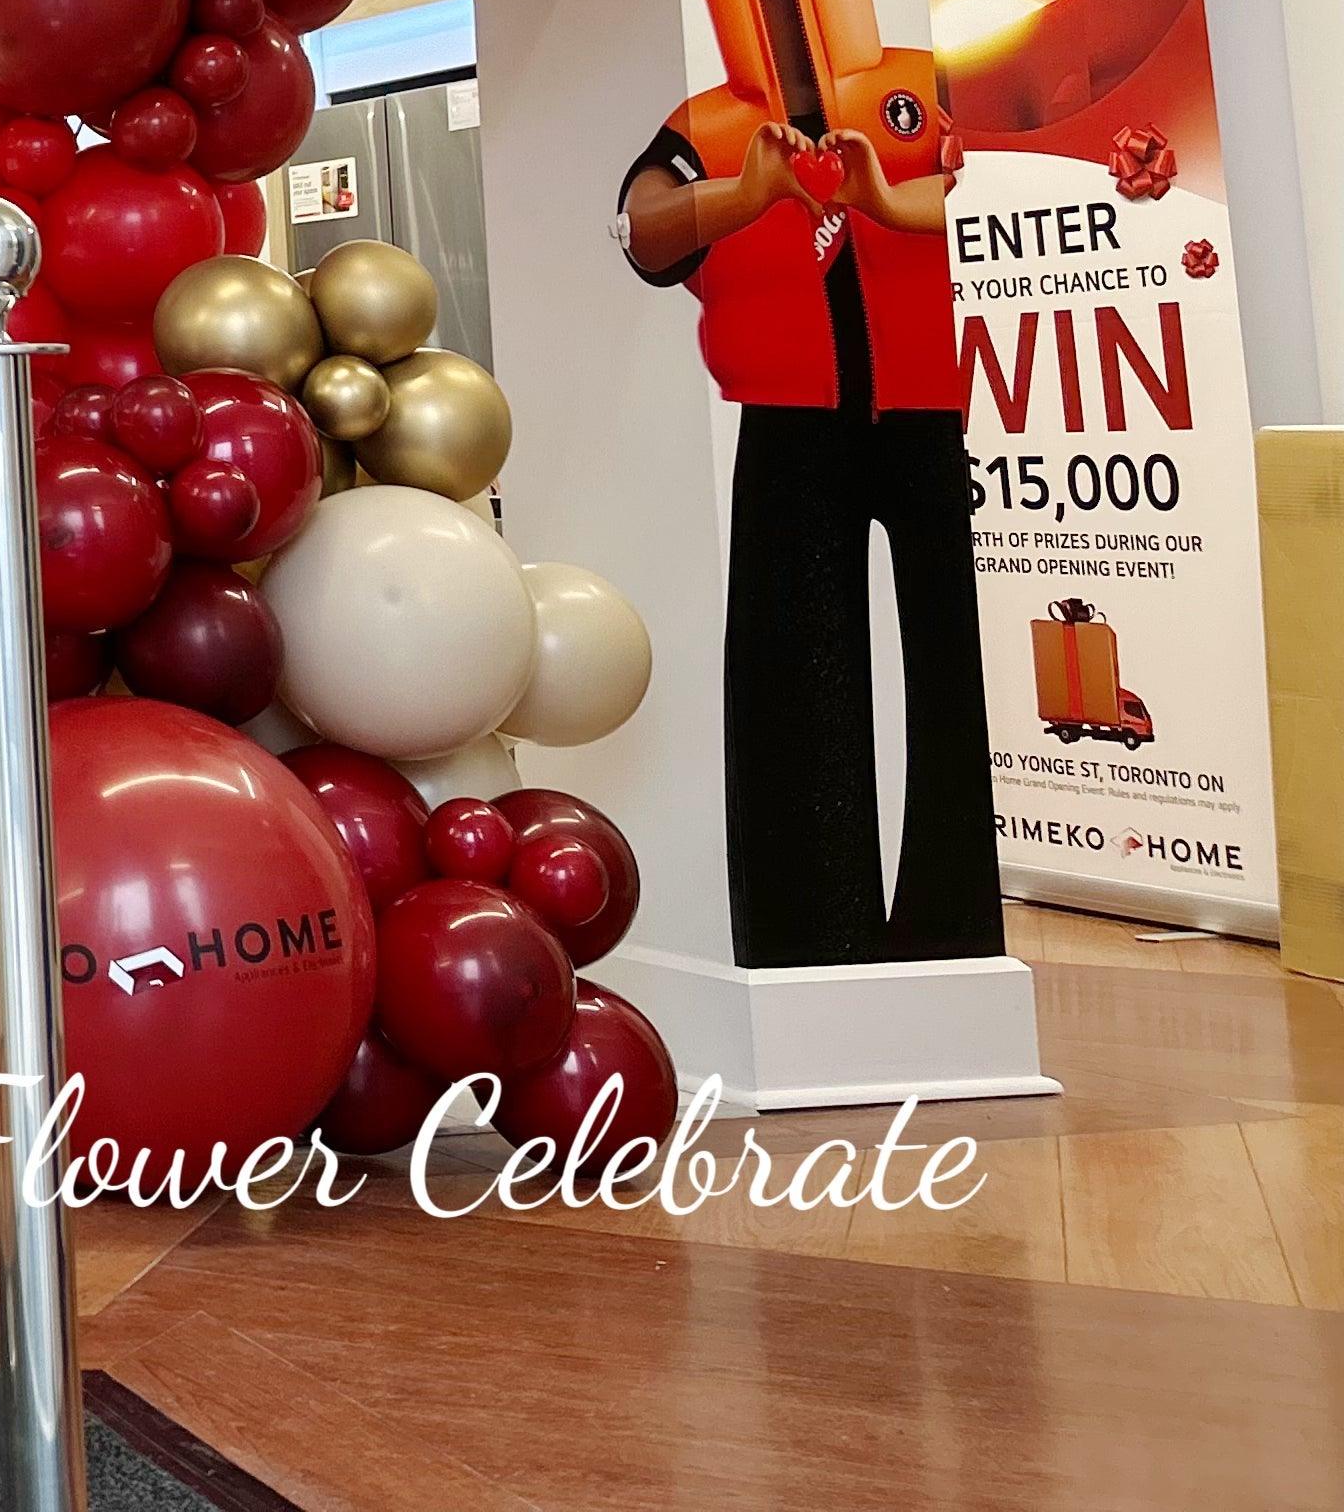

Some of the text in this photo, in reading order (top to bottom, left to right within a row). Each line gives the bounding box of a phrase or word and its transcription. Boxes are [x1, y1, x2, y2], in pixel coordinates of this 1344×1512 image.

[955, 202, 1121, 264] ENTER
[971, 277, 1033, 300] YOUR
[1040, 268, 1130, 295] CHANCE
[1136, 265, 1167, 287] TO
[958, 302, 1193, 434] WIN
[964, 450, 1180, 523] $15,000
[971, 532, 1203, 552] RTH OF PRIZES DURING OUR
[975, 556, 1175, 580] GRAND OPENING EVENT!
[988, 751, 1225, 792] 00 YONGE ST, TORONTO ON
[993, 814, 1243, 871] RIMEKO HOME
[187, 908, 343, 971] HOME
